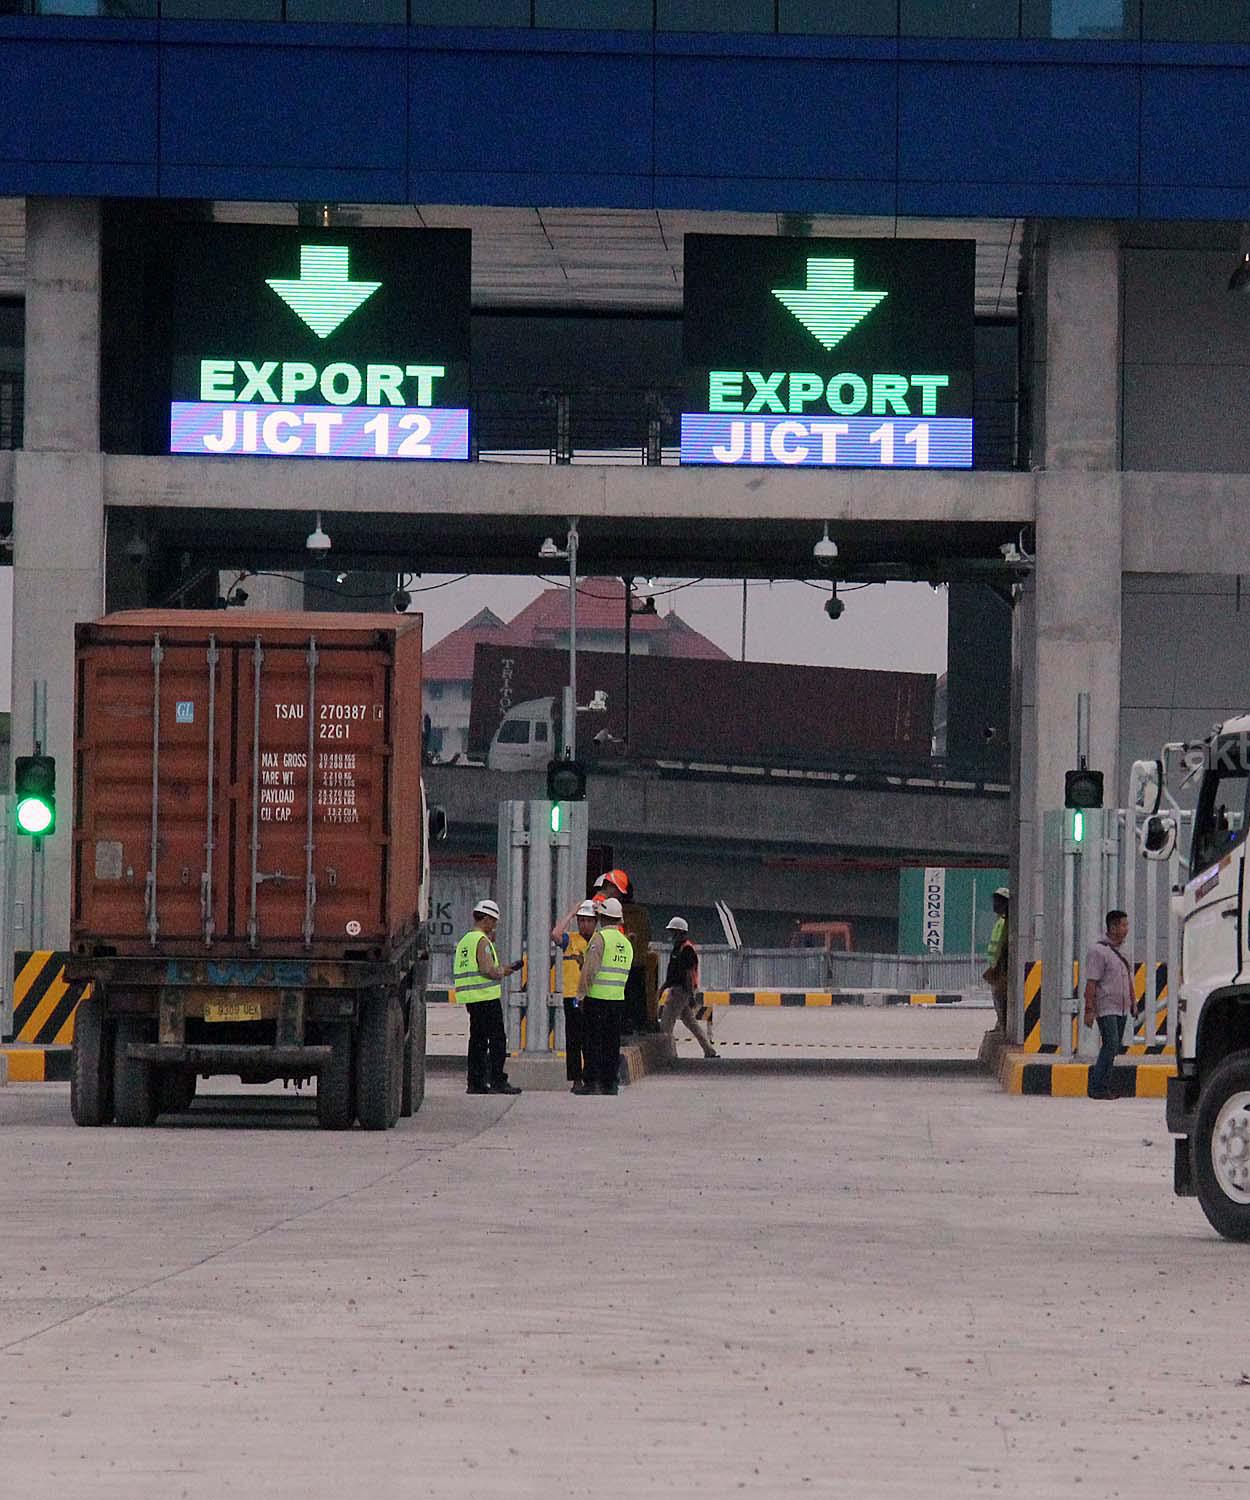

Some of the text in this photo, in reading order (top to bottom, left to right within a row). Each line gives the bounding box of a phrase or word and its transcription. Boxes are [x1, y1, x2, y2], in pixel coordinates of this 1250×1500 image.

[200, 359, 445, 406] EXPORT
[708, 371, 949, 415] EXPORT
[203, 410, 432, 456] JICT 12
[712, 421, 930, 465] JICT 11
[275, 704, 304, 719] TSAU
[320, 704, 367, 720] 270387
[320, 724, 350, 739] 22G1
[261, 752, 279, 767] MAX
[283, 752, 307, 768] GROSS
[262, 771, 280, 785] TARE
[261, 789, 295, 804] PAYLOAD
[927, 885, 941, 919] DONG
